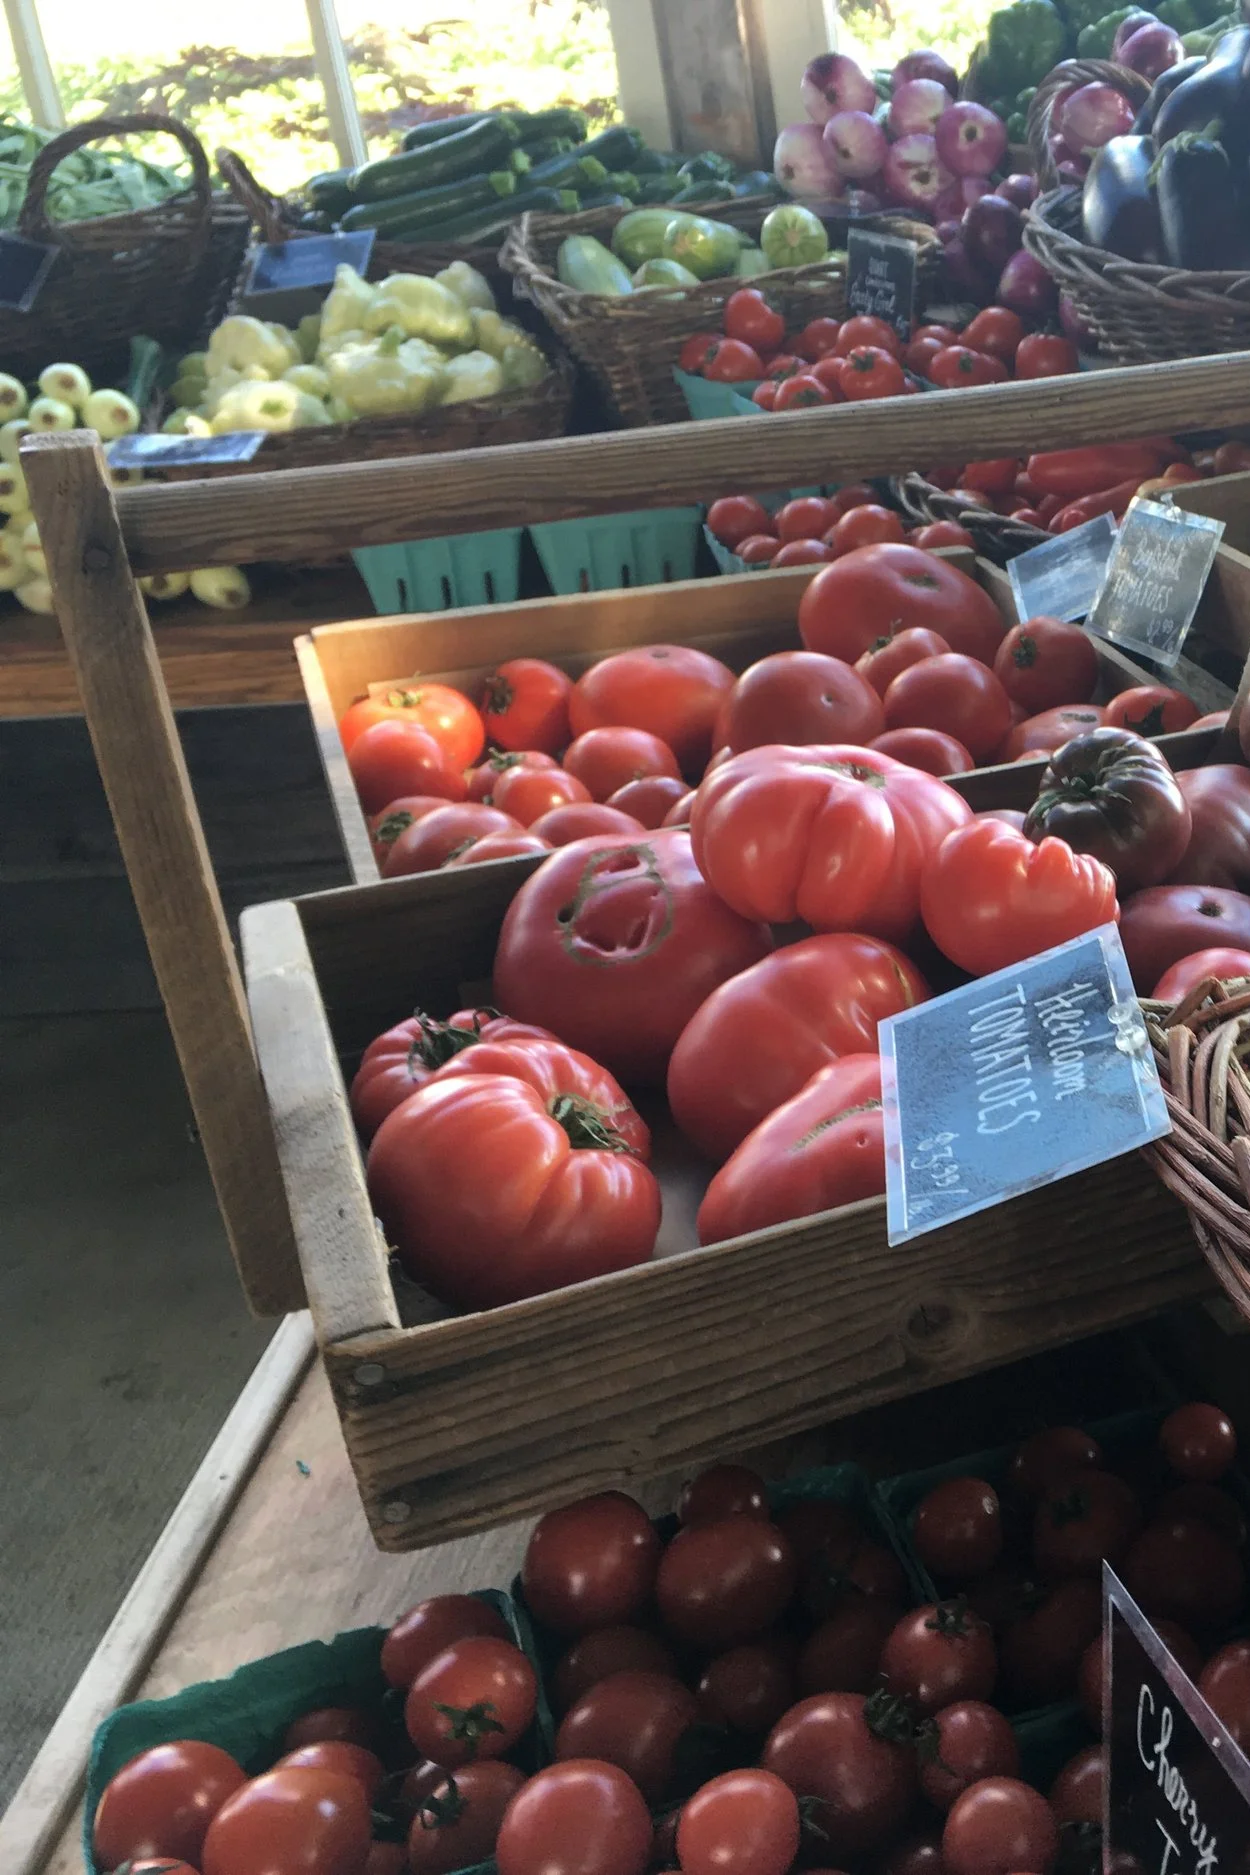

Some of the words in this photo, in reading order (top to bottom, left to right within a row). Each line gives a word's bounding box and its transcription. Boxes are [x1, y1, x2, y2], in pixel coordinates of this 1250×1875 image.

[1110, 569, 1174, 614] TOMATOES
[968, 984, 1041, 1135] TOMATOES
[1034, 981, 1115, 1101] Heirloom
[1137, 1684, 1218, 1875] Cherry
[1155, 1818, 1182, 1875] T
